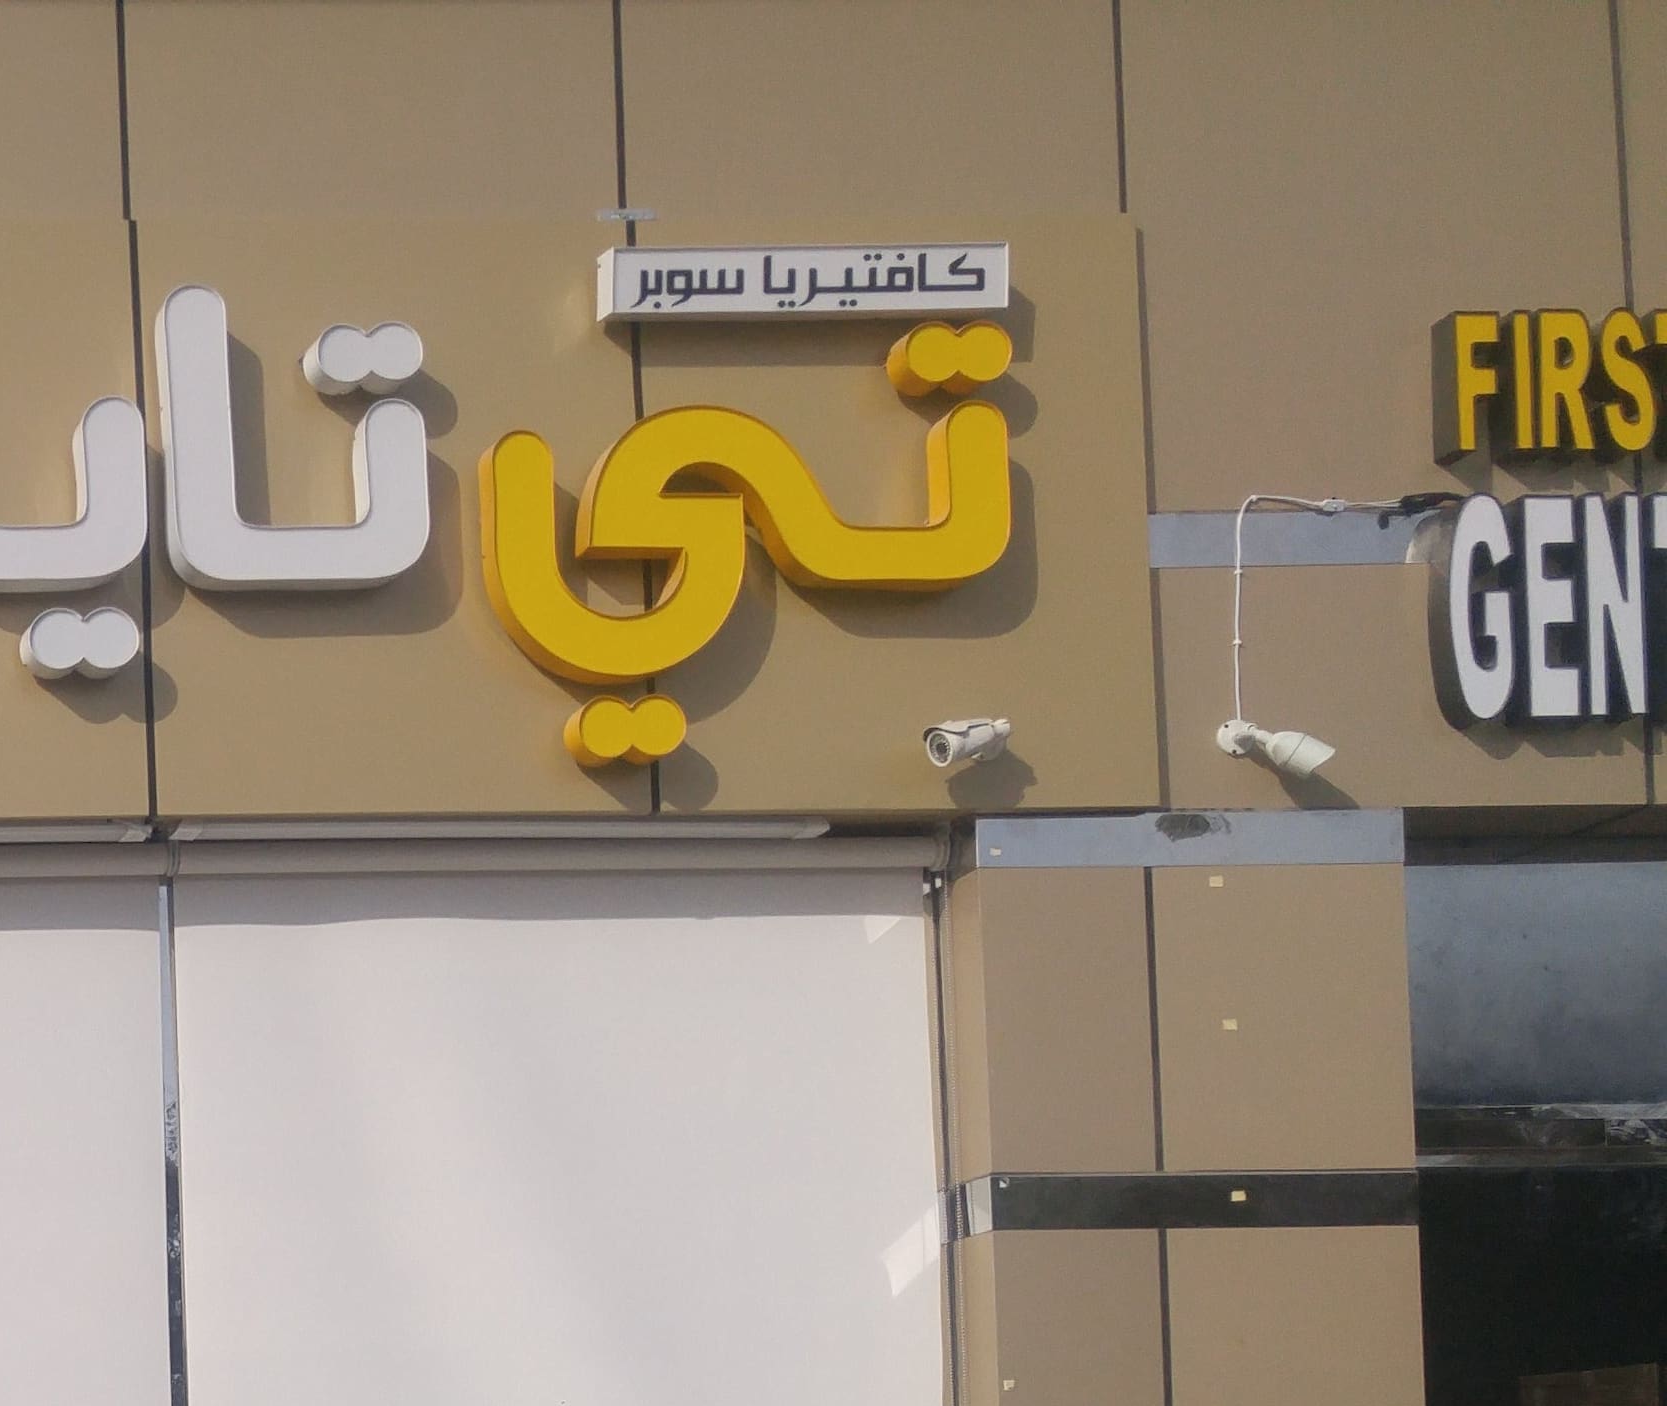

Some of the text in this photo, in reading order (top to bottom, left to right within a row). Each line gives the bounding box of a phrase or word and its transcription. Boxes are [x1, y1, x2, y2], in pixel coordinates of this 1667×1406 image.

[630, 253, 986, 310] كافتيريا سوبر
[1448, 492, 1667, 719] GEN
